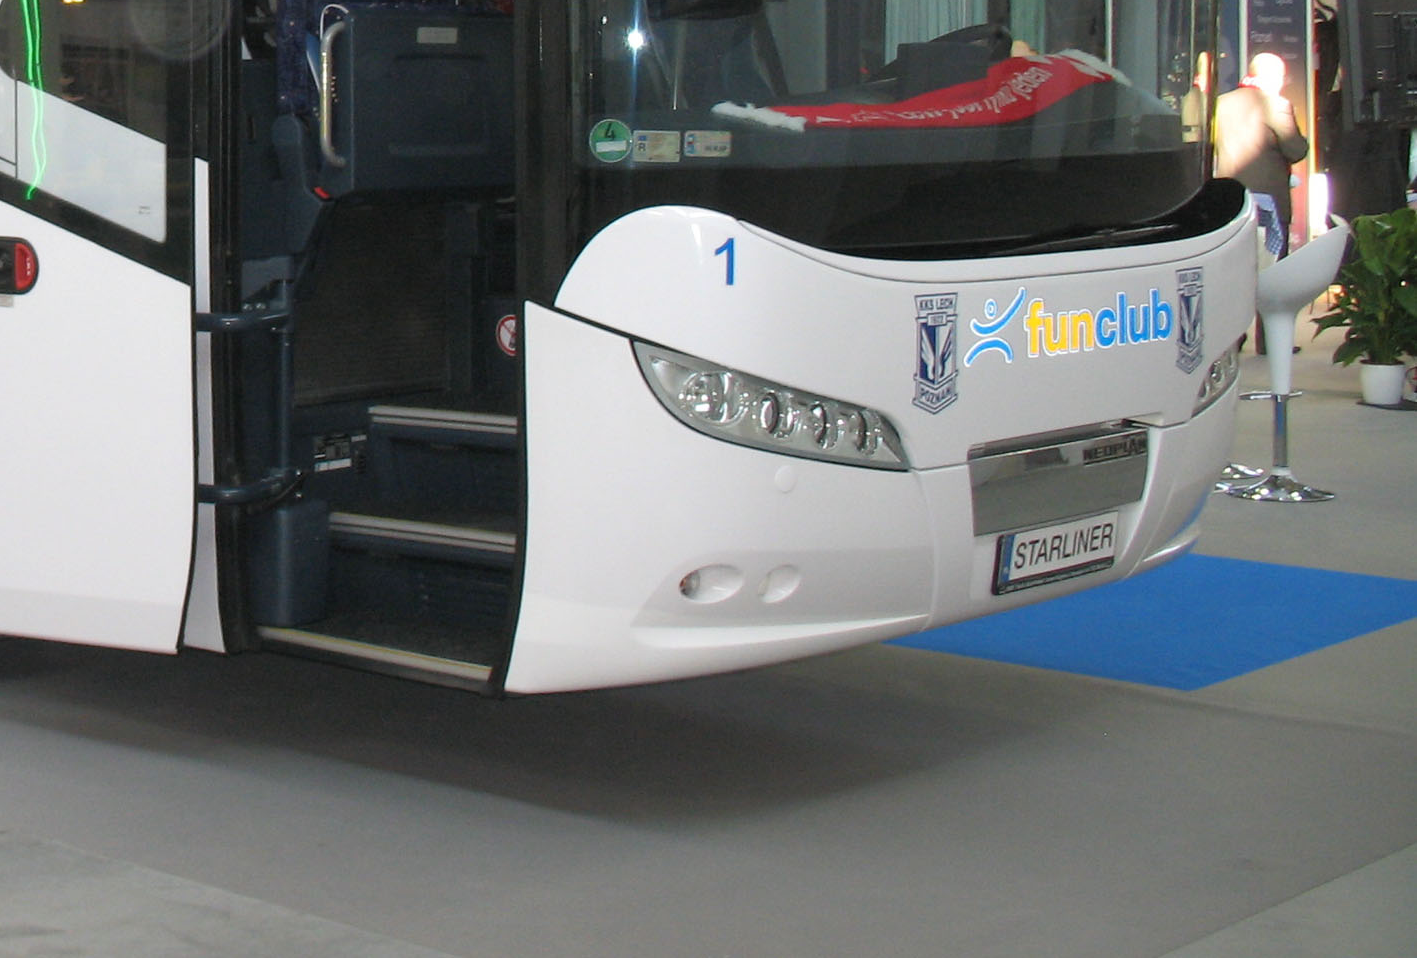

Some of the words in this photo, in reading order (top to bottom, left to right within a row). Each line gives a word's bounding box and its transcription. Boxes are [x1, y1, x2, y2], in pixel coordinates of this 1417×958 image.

[714, 237, 735, 286] 1
[1025, 289, 1174, 358] funclub
[1014, 523, 1114, 569] STARLINER
